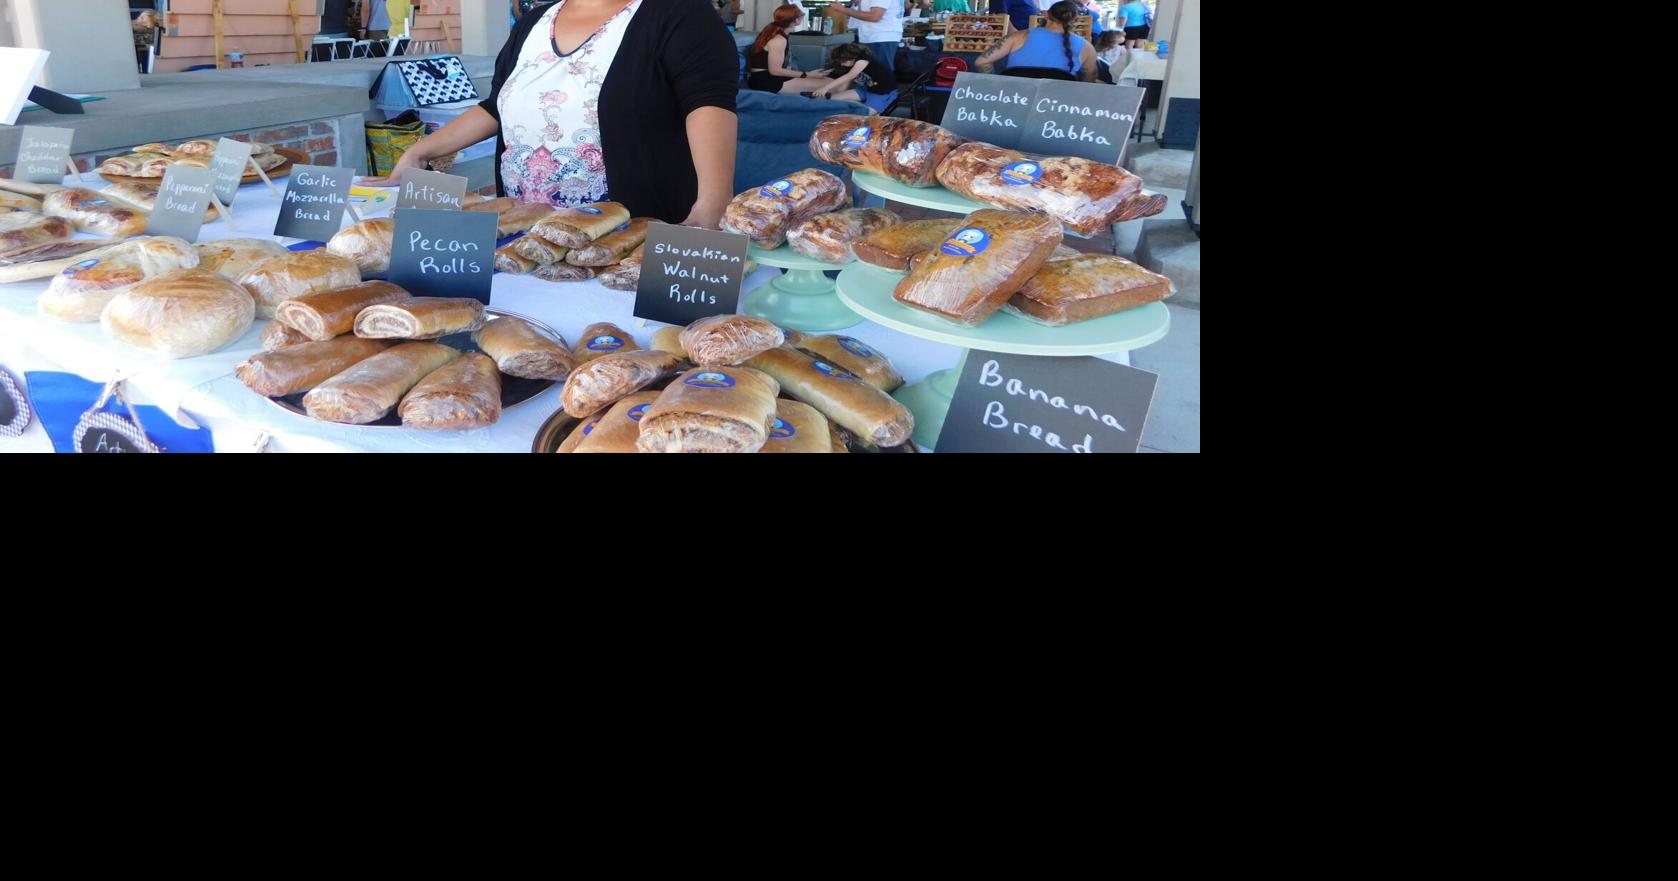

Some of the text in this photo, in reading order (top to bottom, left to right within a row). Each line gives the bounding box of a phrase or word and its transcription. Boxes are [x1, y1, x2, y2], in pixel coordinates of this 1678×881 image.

[953, 86, 1029, 106] Chocolate
[957, 106, 1018, 129] Babka
[1035, 97, 1135, 123] Cinnamon
[1041, 120, 1112, 147] Babka
[28, 163, 59, 175] Bread
[166, 175, 210, 196] Pepperoni
[297, 172, 337, 188] Garlic
[286, 190, 345, 205] Mozzarella
[404, 180, 461, 208] Artisan
[166, 196, 198, 214] Bread
[295, 208, 331, 221] Bread
[409, 230, 480, 253] Pecan
[654, 243, 741, 263] Slovakian
[420, 256, 481, 275] Rolls
[661, 260, 730, 285] Walnut
[668, 283, 717, 306] Rolls
[978, 359, 1127, 433] Banana
